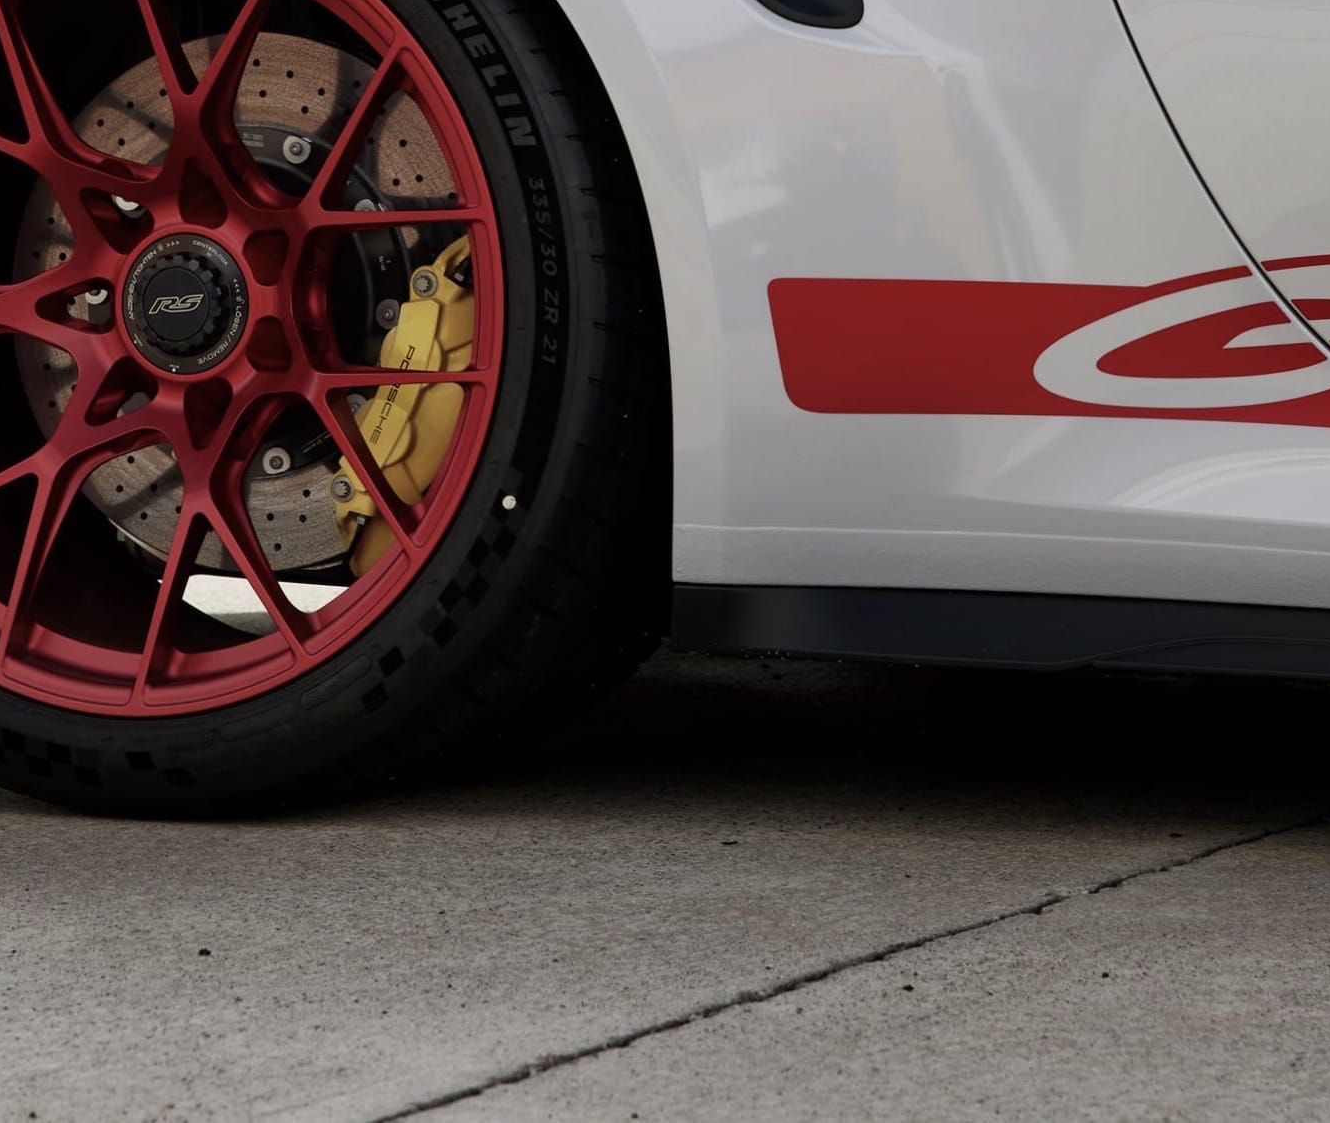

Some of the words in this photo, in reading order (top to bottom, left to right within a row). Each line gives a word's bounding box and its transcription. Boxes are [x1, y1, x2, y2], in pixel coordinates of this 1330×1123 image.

[528, 176, 558, 277] 335/30
[148, 293, 205, 315] RS
[541, 286, 560, 325] ZR
[197, 341, 229, 365] REMOVE
[540, 333, 558, 366] 21
